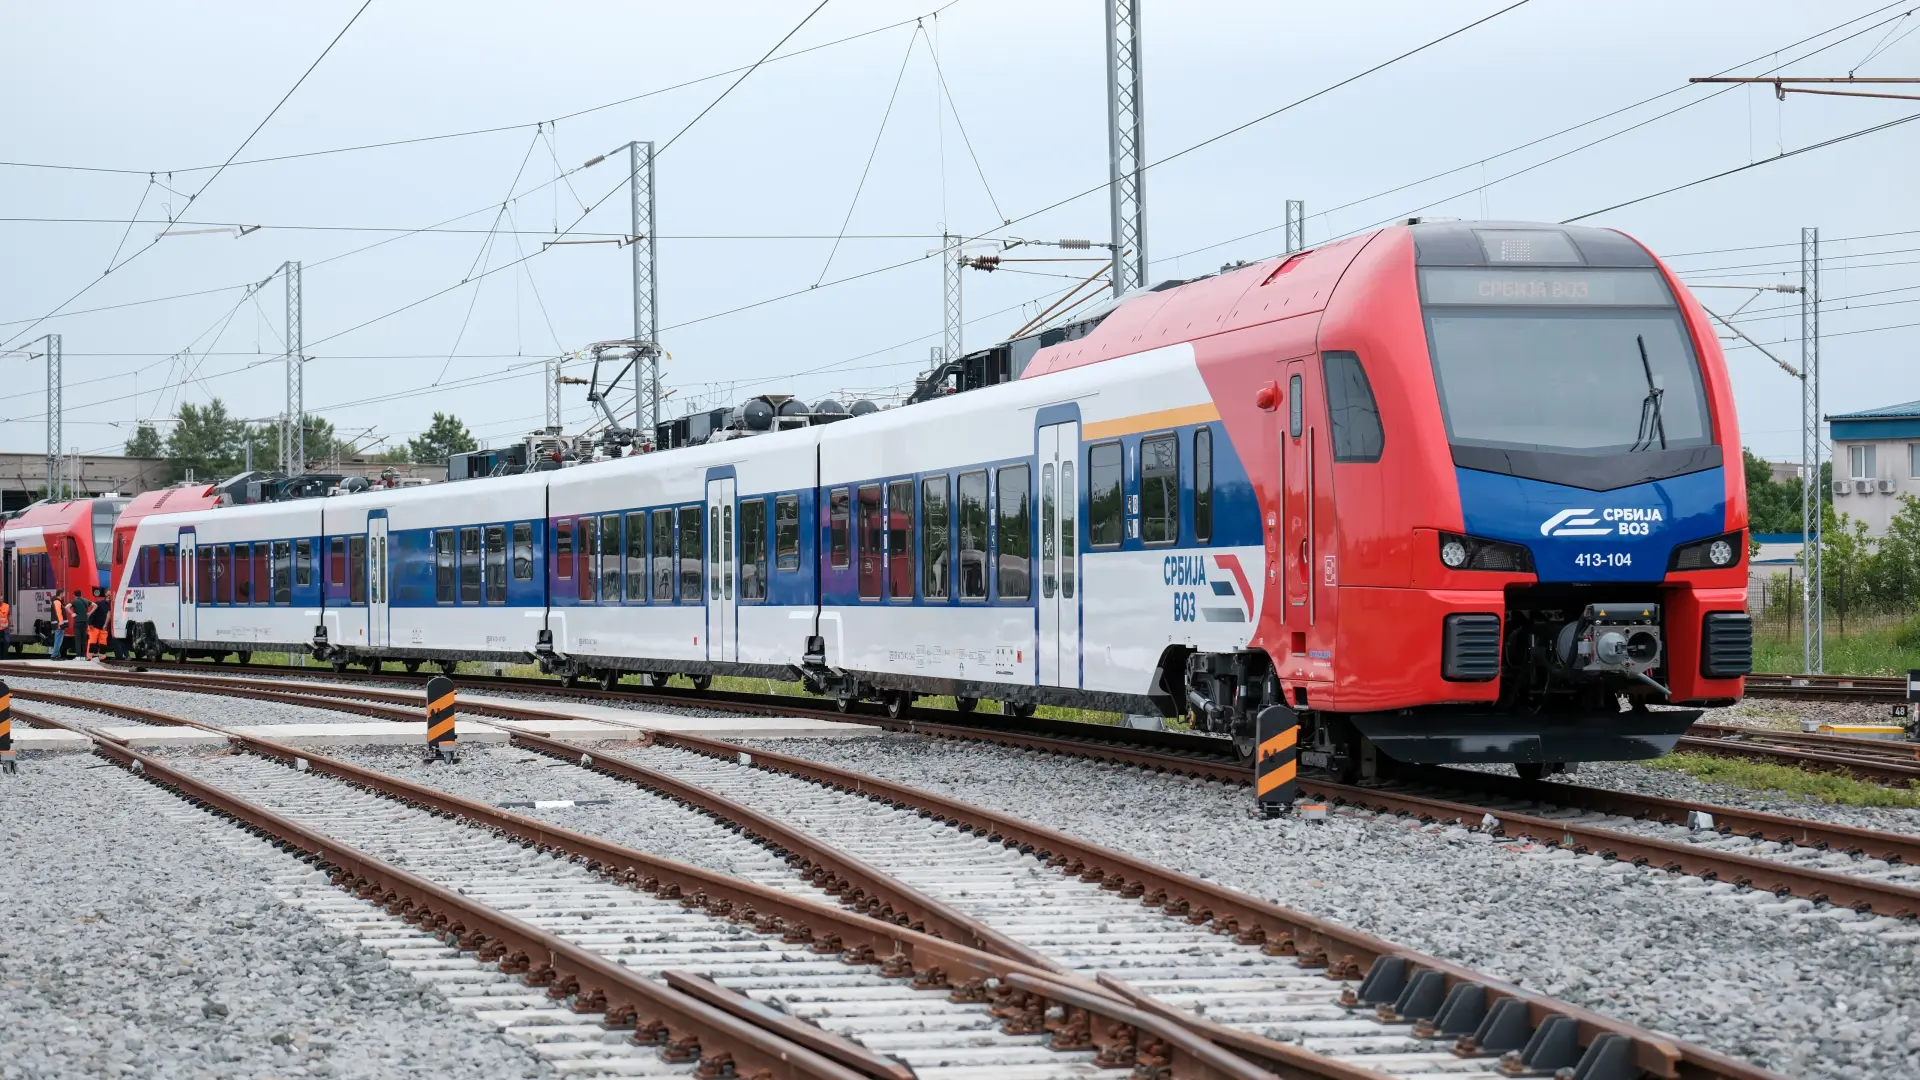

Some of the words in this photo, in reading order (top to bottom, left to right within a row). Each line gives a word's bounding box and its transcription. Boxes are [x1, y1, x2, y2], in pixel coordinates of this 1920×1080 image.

[1478, 281, 1547, 298] СРБИЈА
[1552, 281, 1588, 298] ВОЗ
[1129, 446, 1134, 482] 1
[883, 482, 888, 509] 2
[990, 467, 995, 497] 2
[1603, 508, 1663, 522] СРБИЈА
[1618, 522, 1650, 536] ВОЗ
[1163, 555, 1207, 586] СРБИЈА
[1575, 553, 1632, 567] 413-104
[1173, 591, 1196, 622] ВОЗ
